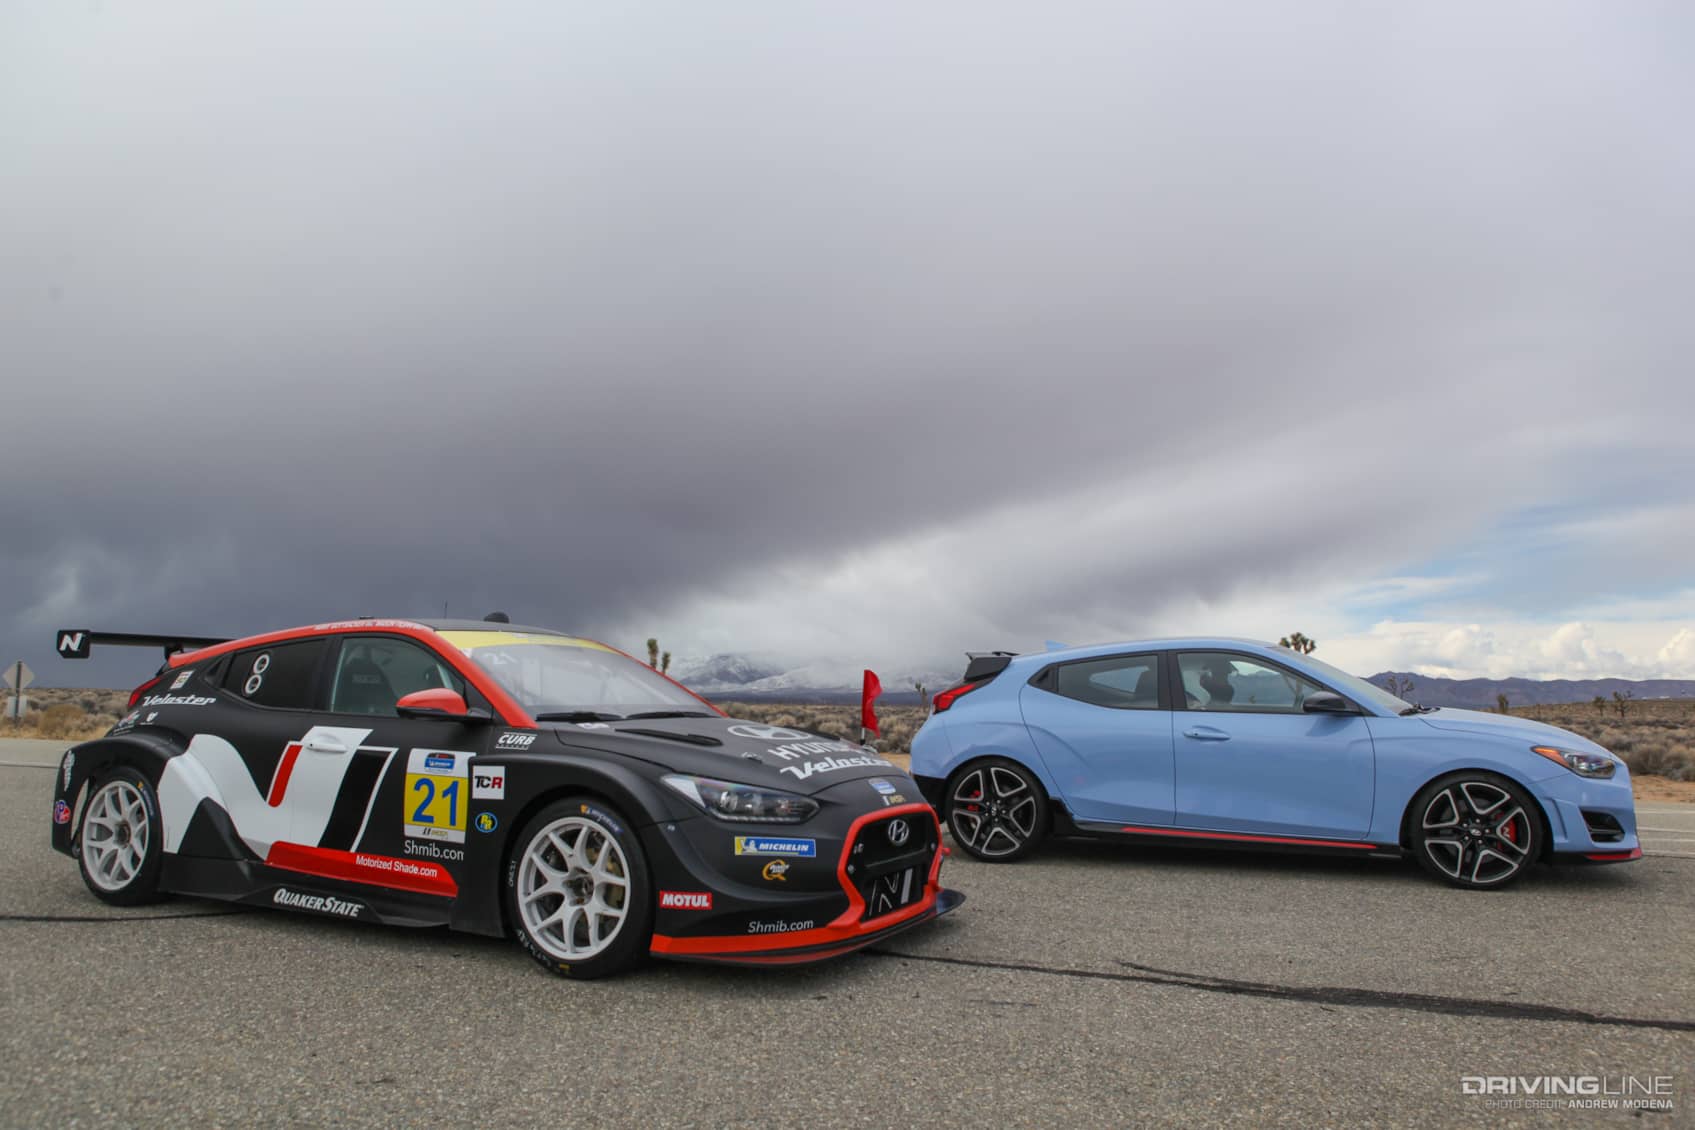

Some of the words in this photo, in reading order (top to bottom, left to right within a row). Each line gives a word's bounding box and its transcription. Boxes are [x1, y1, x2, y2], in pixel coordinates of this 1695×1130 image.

[59, 633, 84, 651] N
[498, 734, 537, 746] CURB
[474, 775, 503, 789] TCR
[412, 777, 459, 827] 21
[758, 843, 809, 852] MICHELIN
[355, 855, 392, 871] Motorized
[393, 861, 438, 878] Shade.com
[662, 893, 709, 907] MOTUL
[747, 920, 814, 933] Shmib.com
